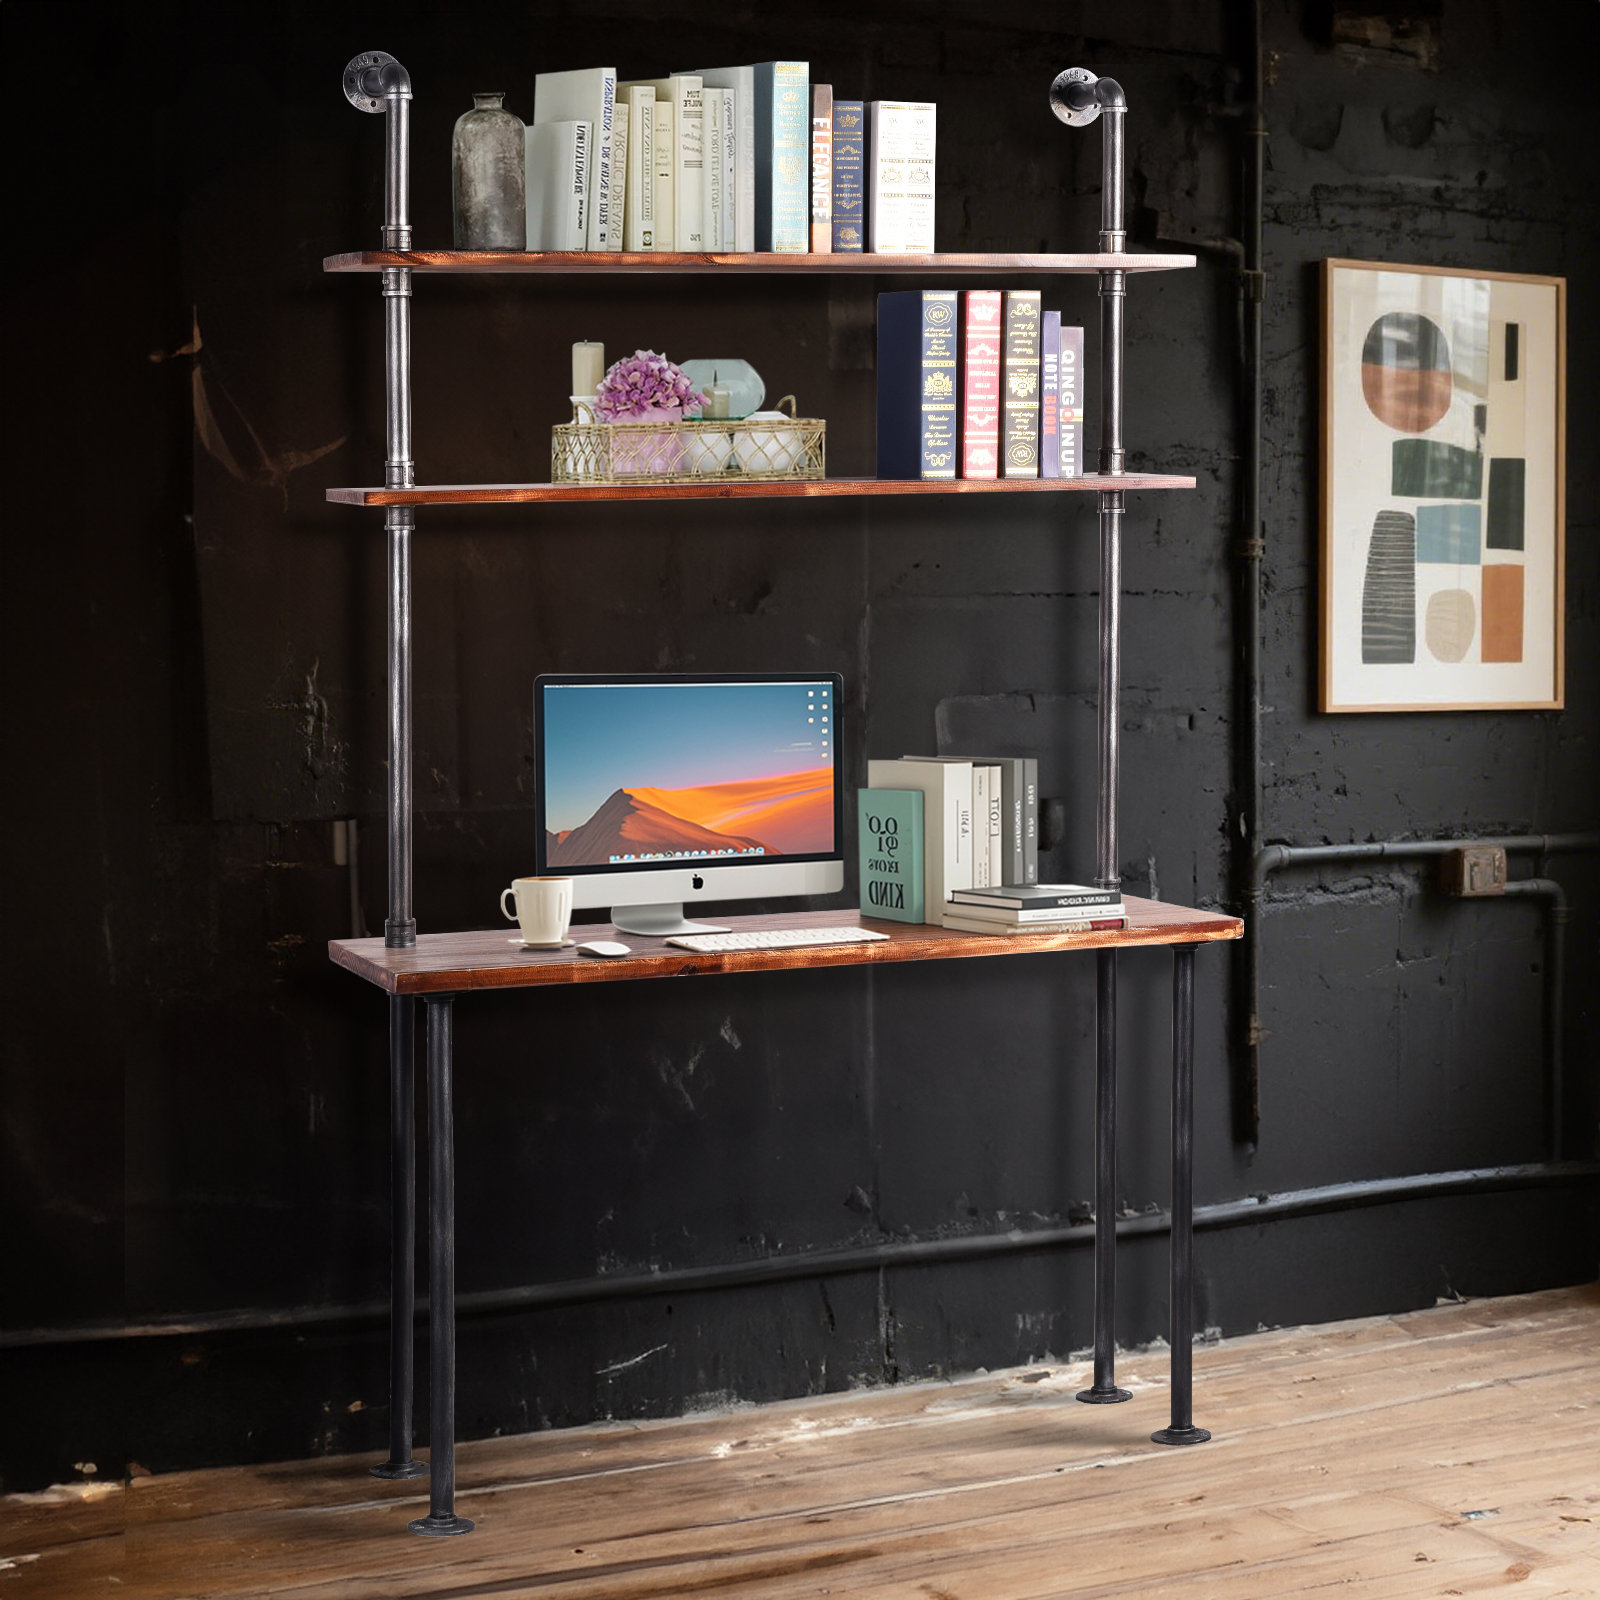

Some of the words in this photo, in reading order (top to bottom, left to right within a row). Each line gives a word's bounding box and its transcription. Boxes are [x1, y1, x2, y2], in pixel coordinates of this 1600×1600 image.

[812, 116, 831, 220] ELEGANCE
[1044, 353, 1058, 390] NOTE
[1043, 395, 1057, 435] BOOK
